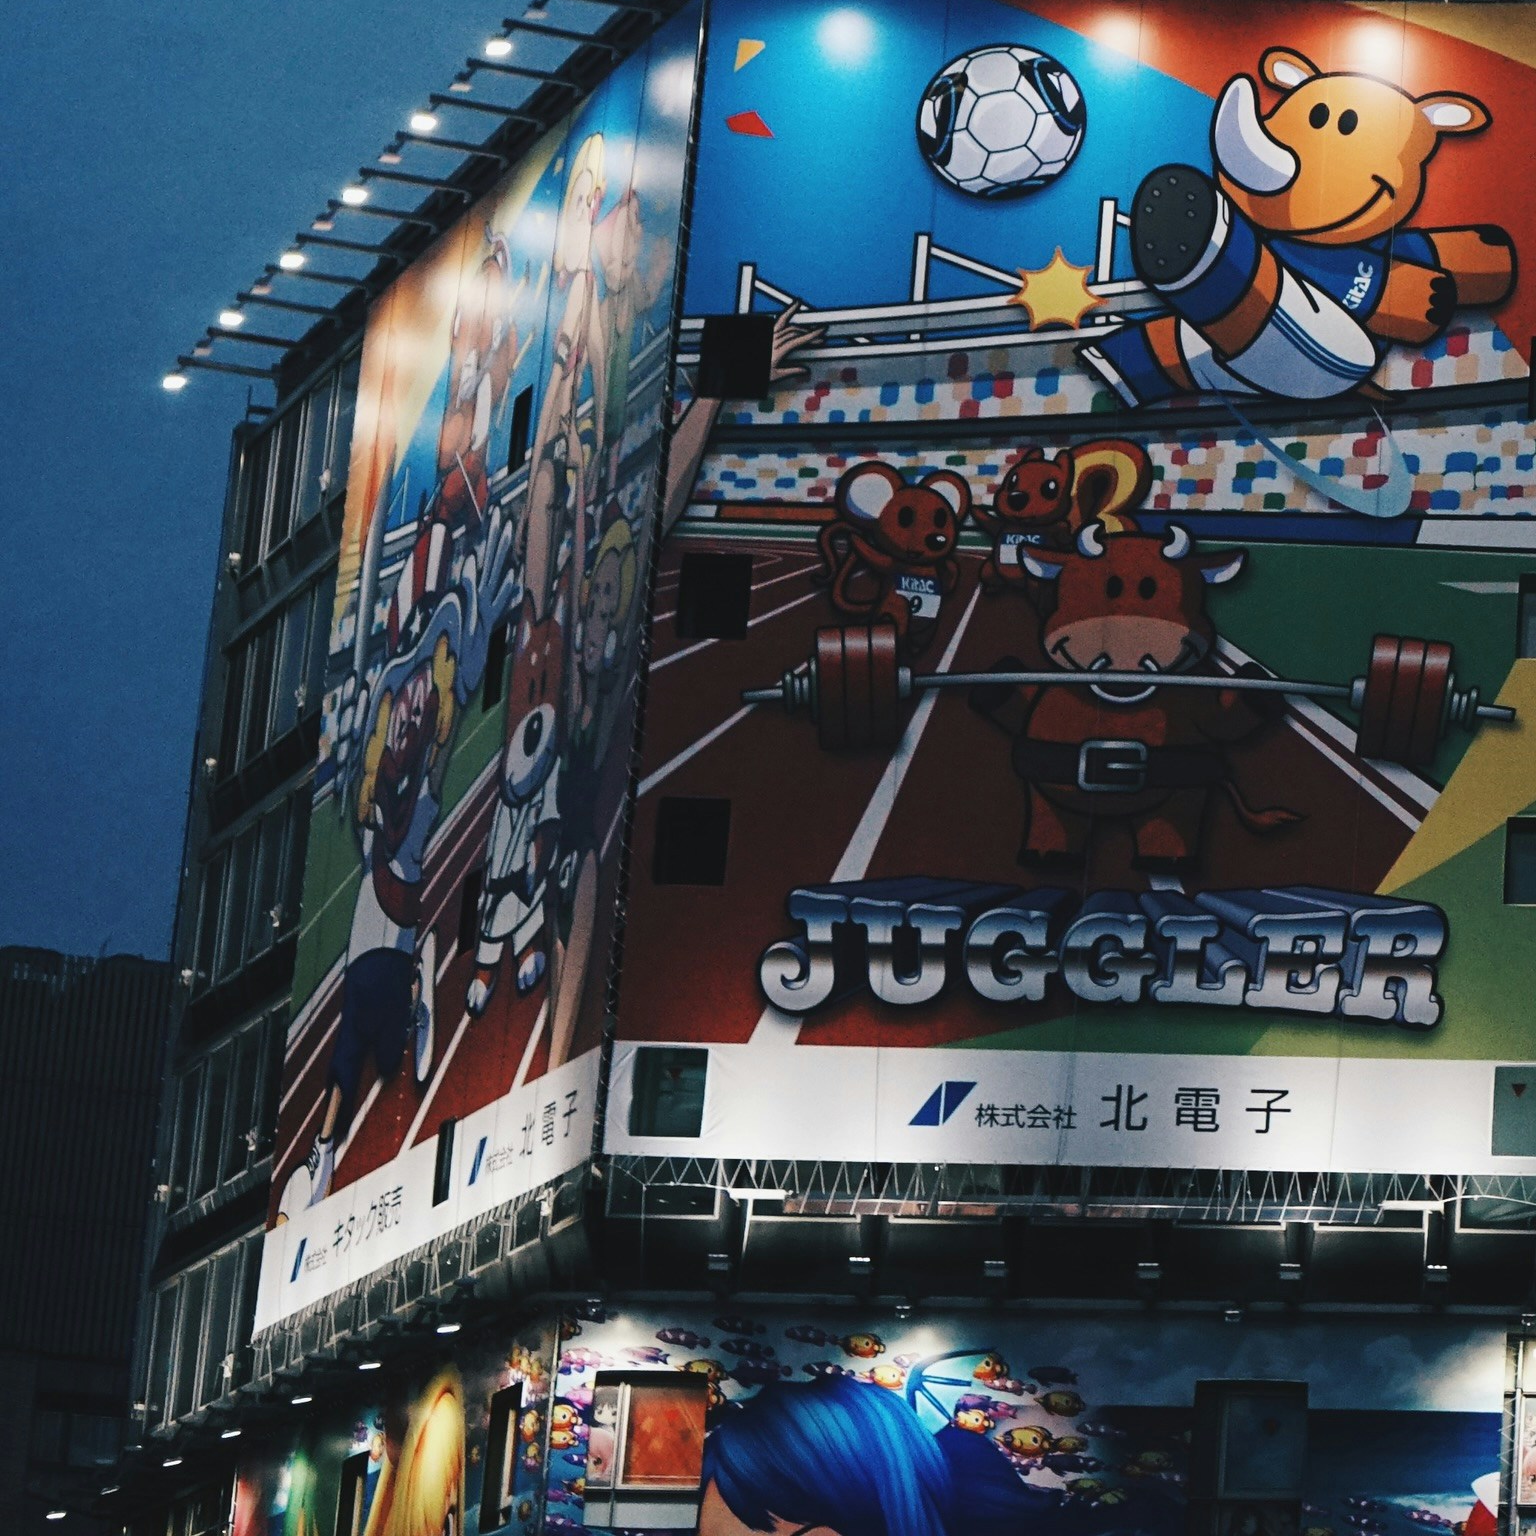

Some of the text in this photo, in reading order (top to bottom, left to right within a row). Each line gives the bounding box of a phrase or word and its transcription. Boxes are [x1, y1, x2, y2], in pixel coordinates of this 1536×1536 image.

[758, 879, 1446, 1031] JUGGLER
[973, 1102, 1077, 1132] 株式会社
[1099, 1083, 1292, 1136] 北電子
